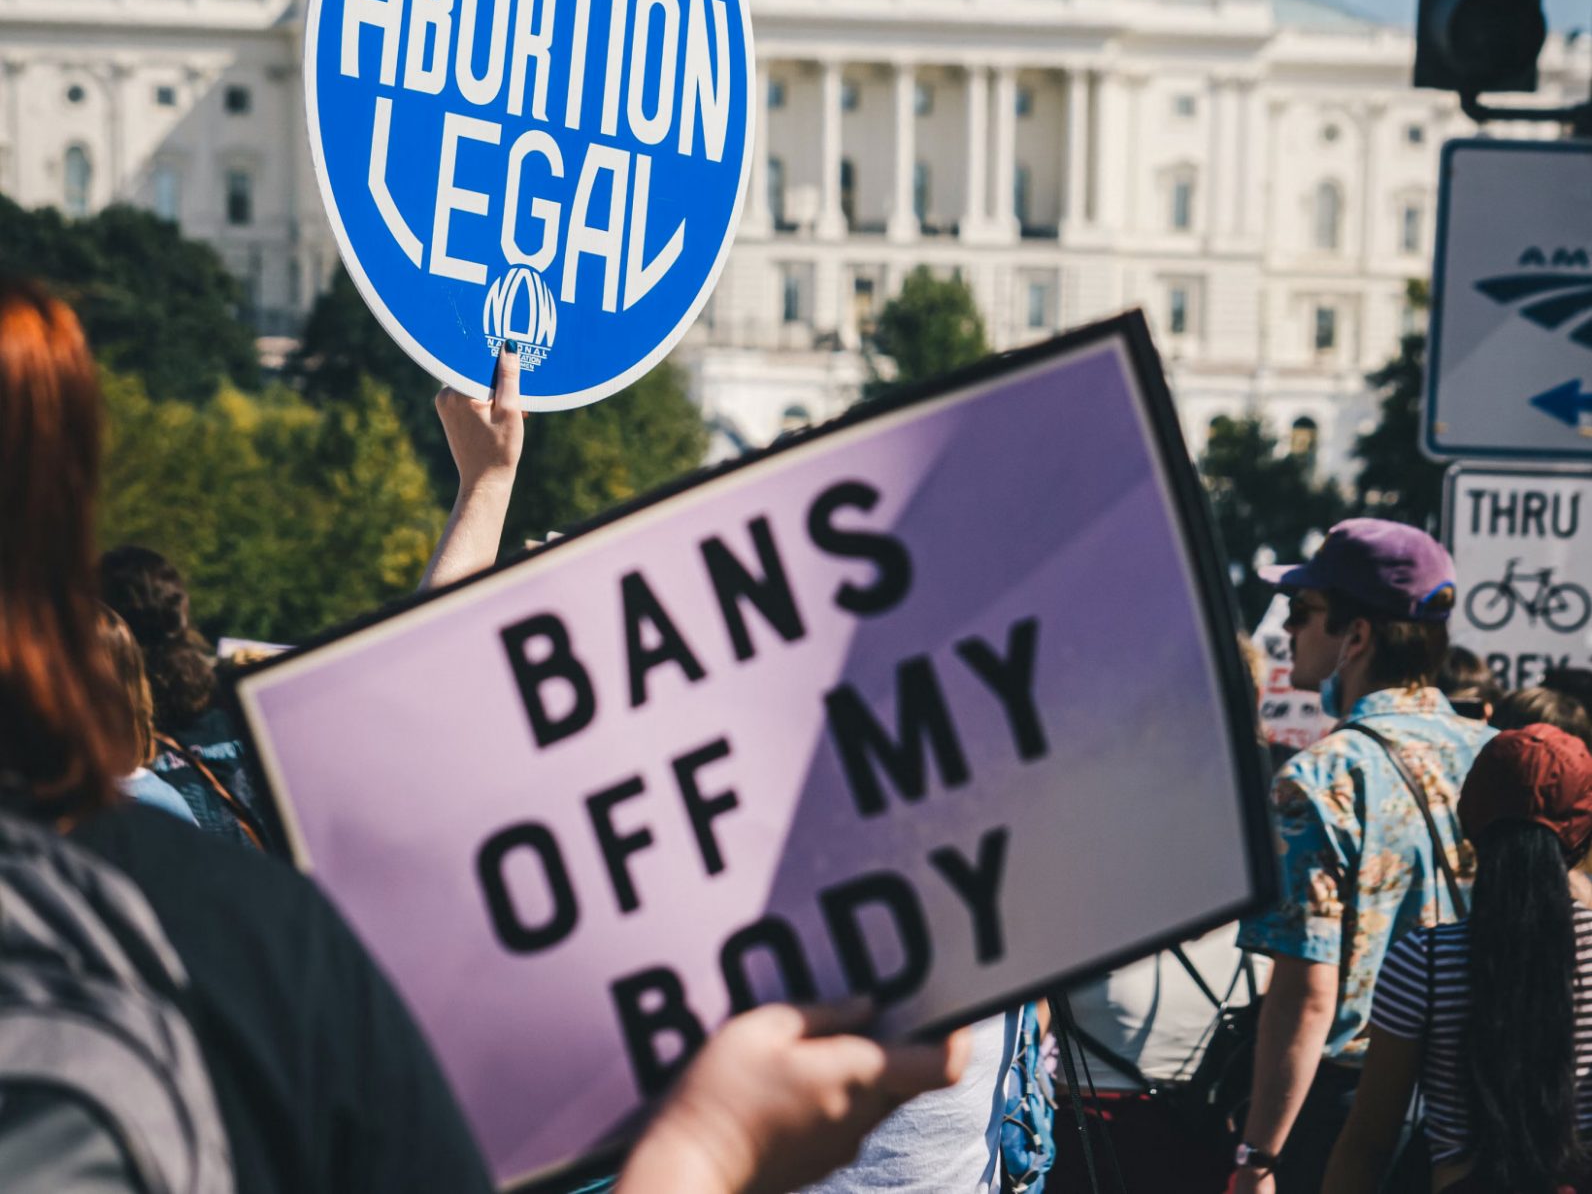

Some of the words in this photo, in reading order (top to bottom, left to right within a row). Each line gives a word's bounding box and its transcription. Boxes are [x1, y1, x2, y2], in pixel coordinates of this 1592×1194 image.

[368, 97, 686, 312] LEGAL
[483, 267, 557, 347] NOW
[487, 338, 547, 356] NAONAL
[1467, 490, 1580, 539] THRU
[499, 479, 914, 749] BANS
[475, 737, 740, 954] OFF
[822, 617, 1049, 815] MY
